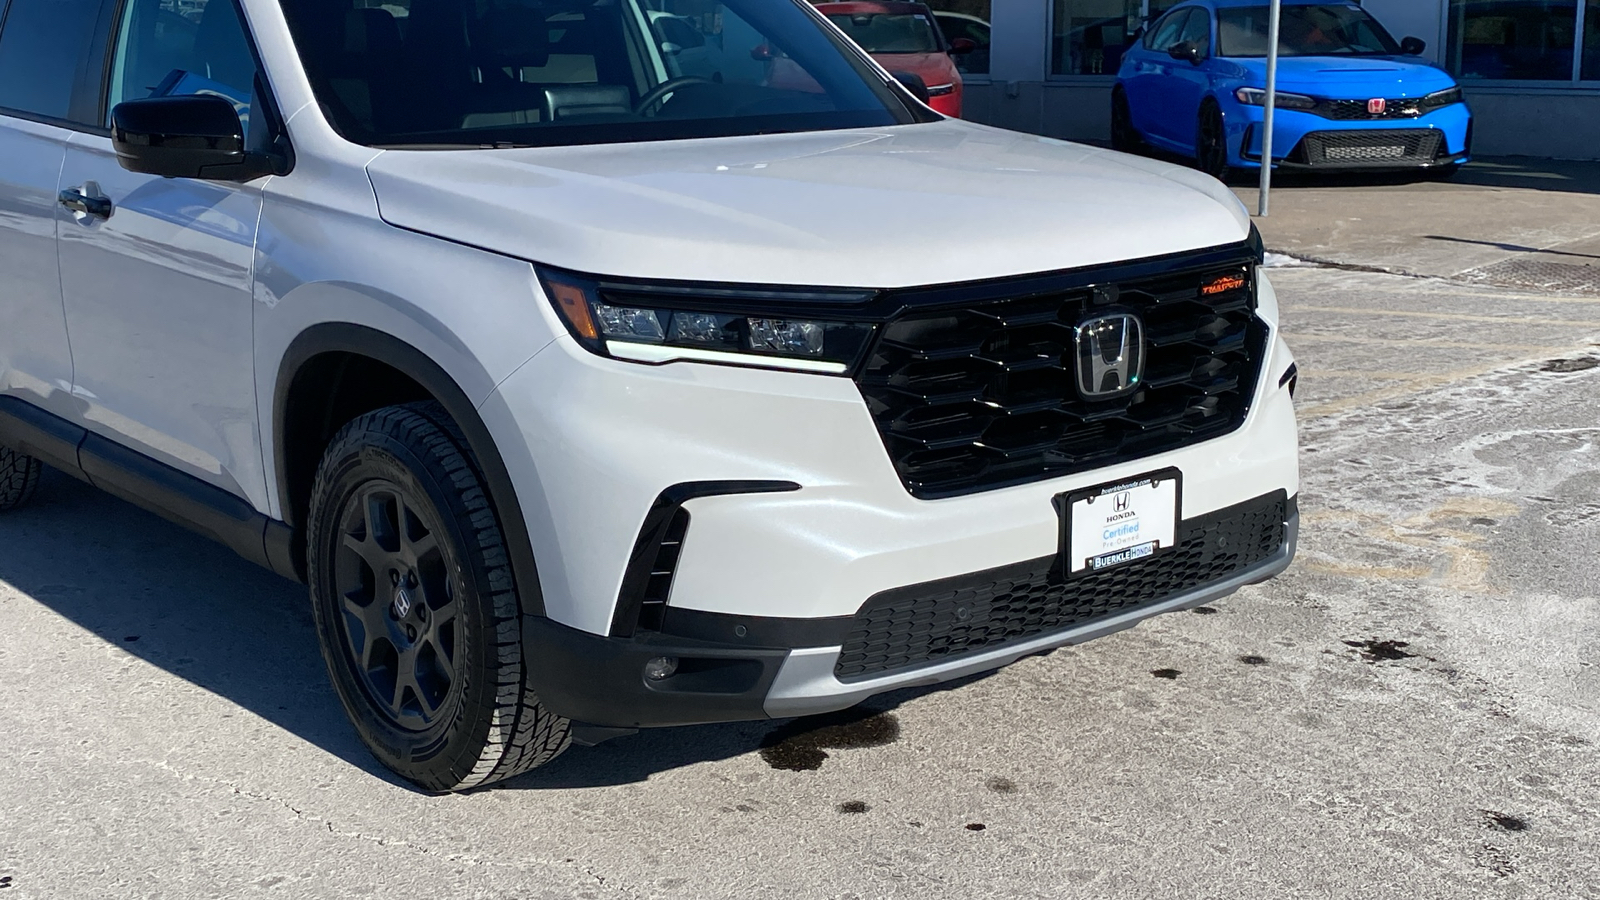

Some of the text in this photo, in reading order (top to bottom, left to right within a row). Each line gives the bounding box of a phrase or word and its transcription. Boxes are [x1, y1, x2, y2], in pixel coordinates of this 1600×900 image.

[1106, 510, 1136, 523] HONDA
[1103, 522, 1139, 540] Certified
[1094, 546, 1152, 568] BUERKLE HONDA
